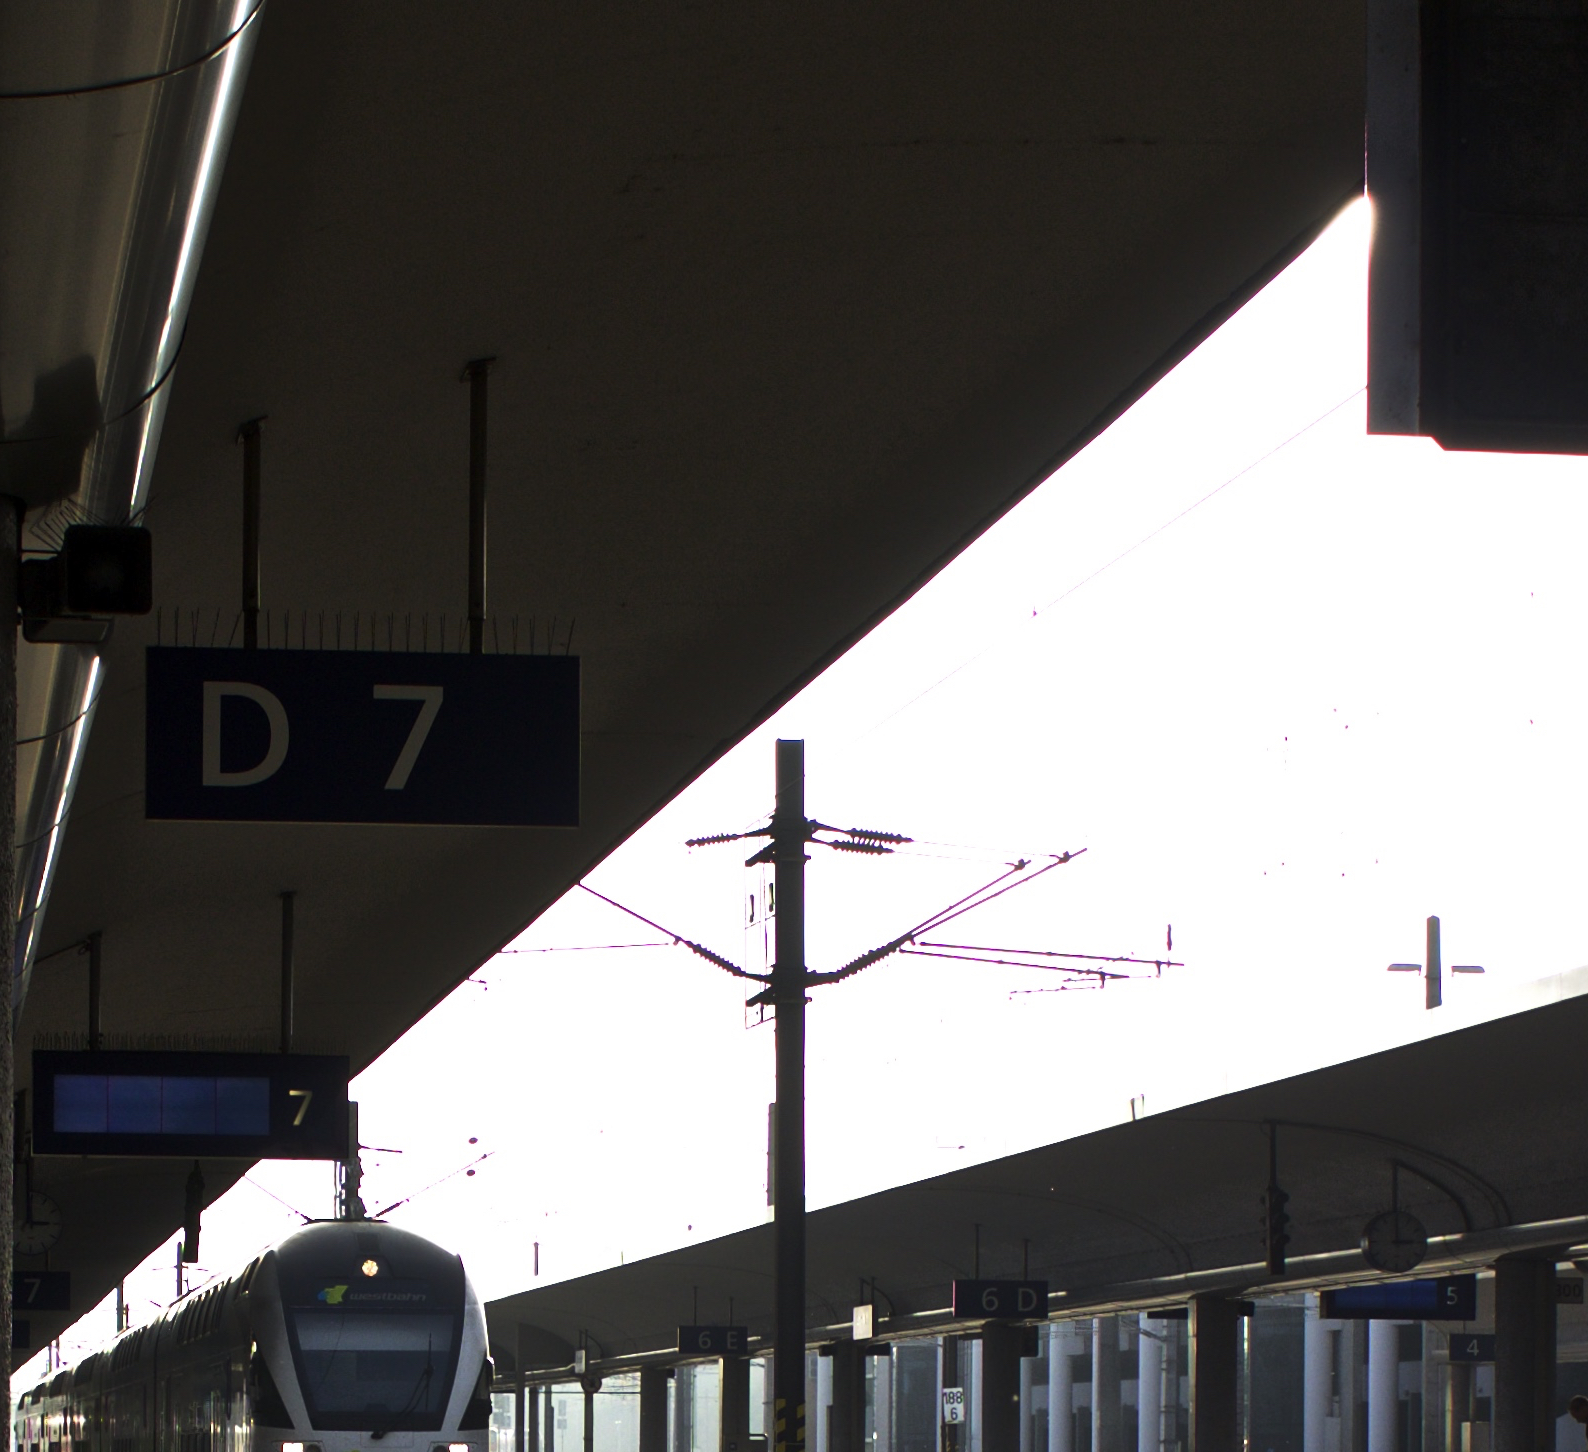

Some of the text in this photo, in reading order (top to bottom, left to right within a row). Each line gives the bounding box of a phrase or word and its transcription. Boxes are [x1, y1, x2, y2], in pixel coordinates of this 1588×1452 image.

[201, 680, 445, 791] D 7
[288, 1089, 313, 1127] 7
[23, 1278, 42, 1304] 7
[349, 1291, 427, 1302] westbahn
[981, 1287, 1037, 1312] 6 D
[1446, 1286, 1459, 1306] 5
[698, 1330, 738, 1350] 6 E
[1466, 1338, 1480, 1357] 4
[950, 1407, 959, 1421] 6
